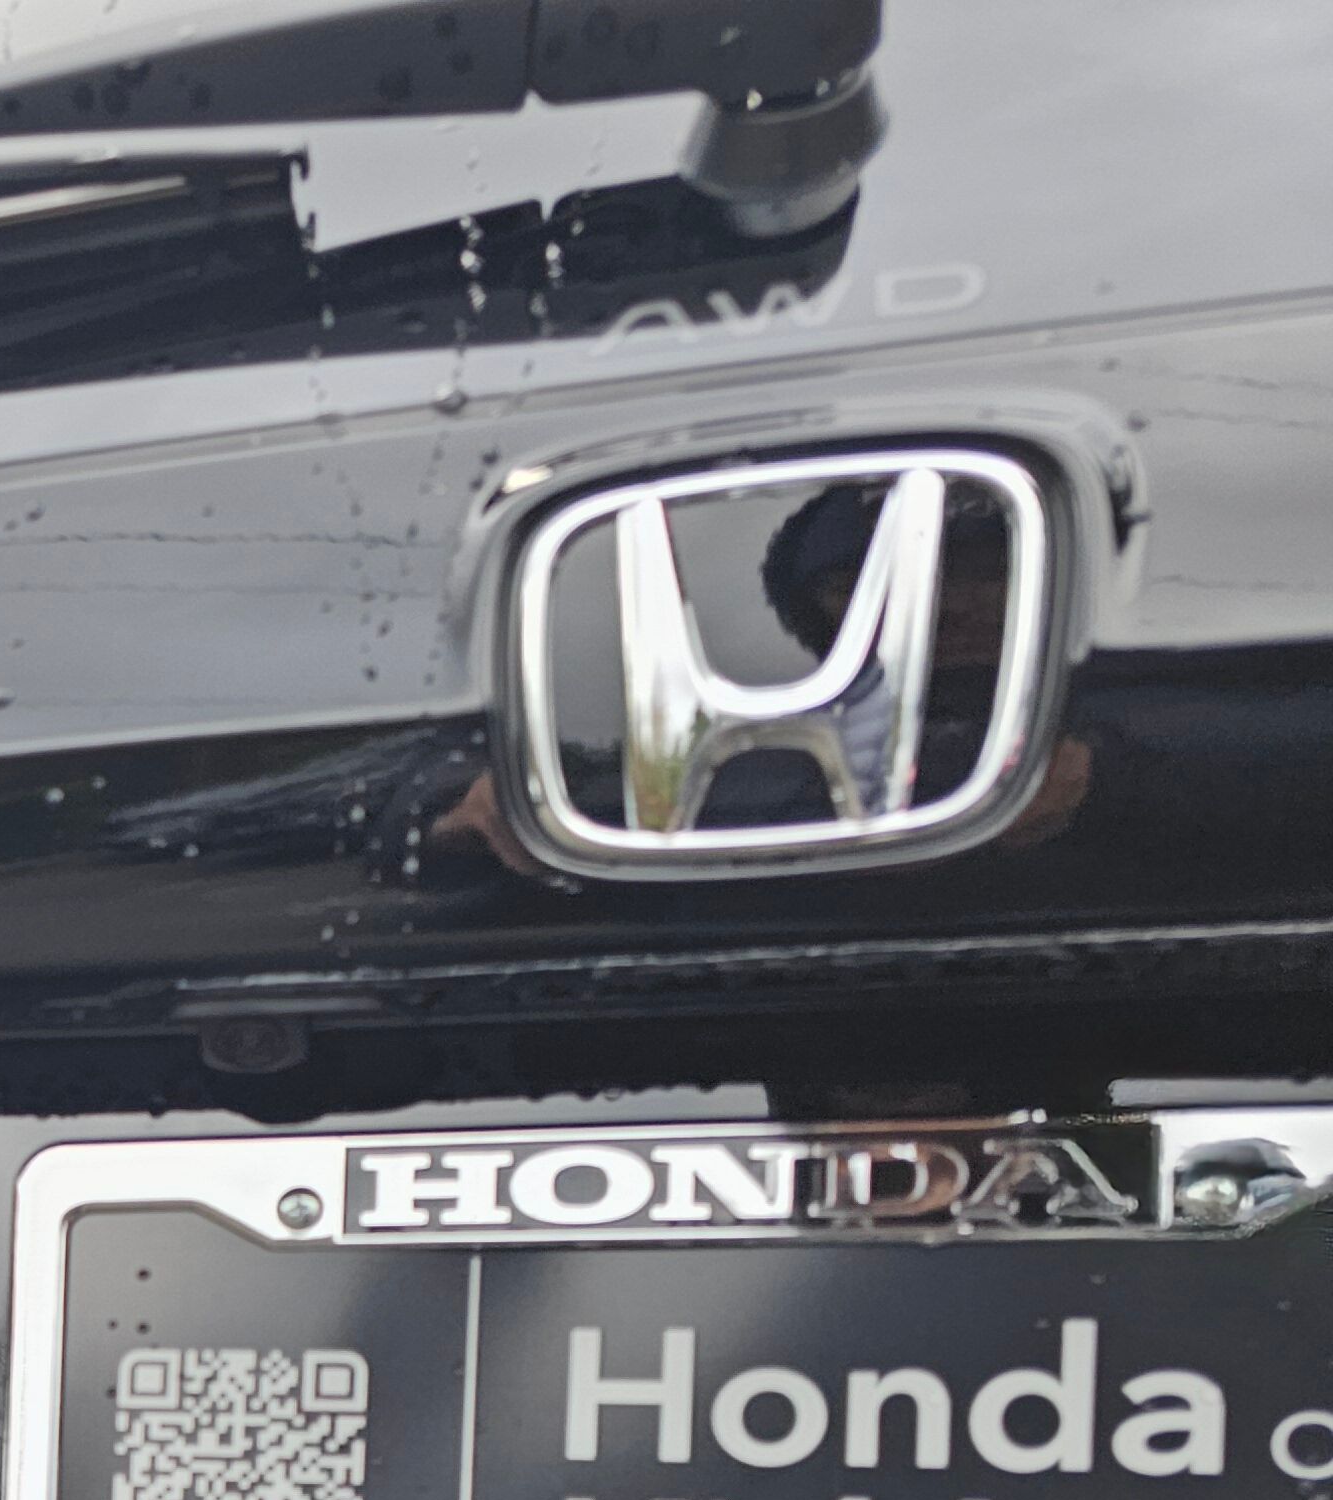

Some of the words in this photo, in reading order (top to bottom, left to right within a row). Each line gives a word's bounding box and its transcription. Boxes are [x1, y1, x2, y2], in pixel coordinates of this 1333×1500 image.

[589, 261, 989, 357] AWD
[357, 1138, 1138, 1229] HONDA
[565, 1317, 1226, 1478] Honda
